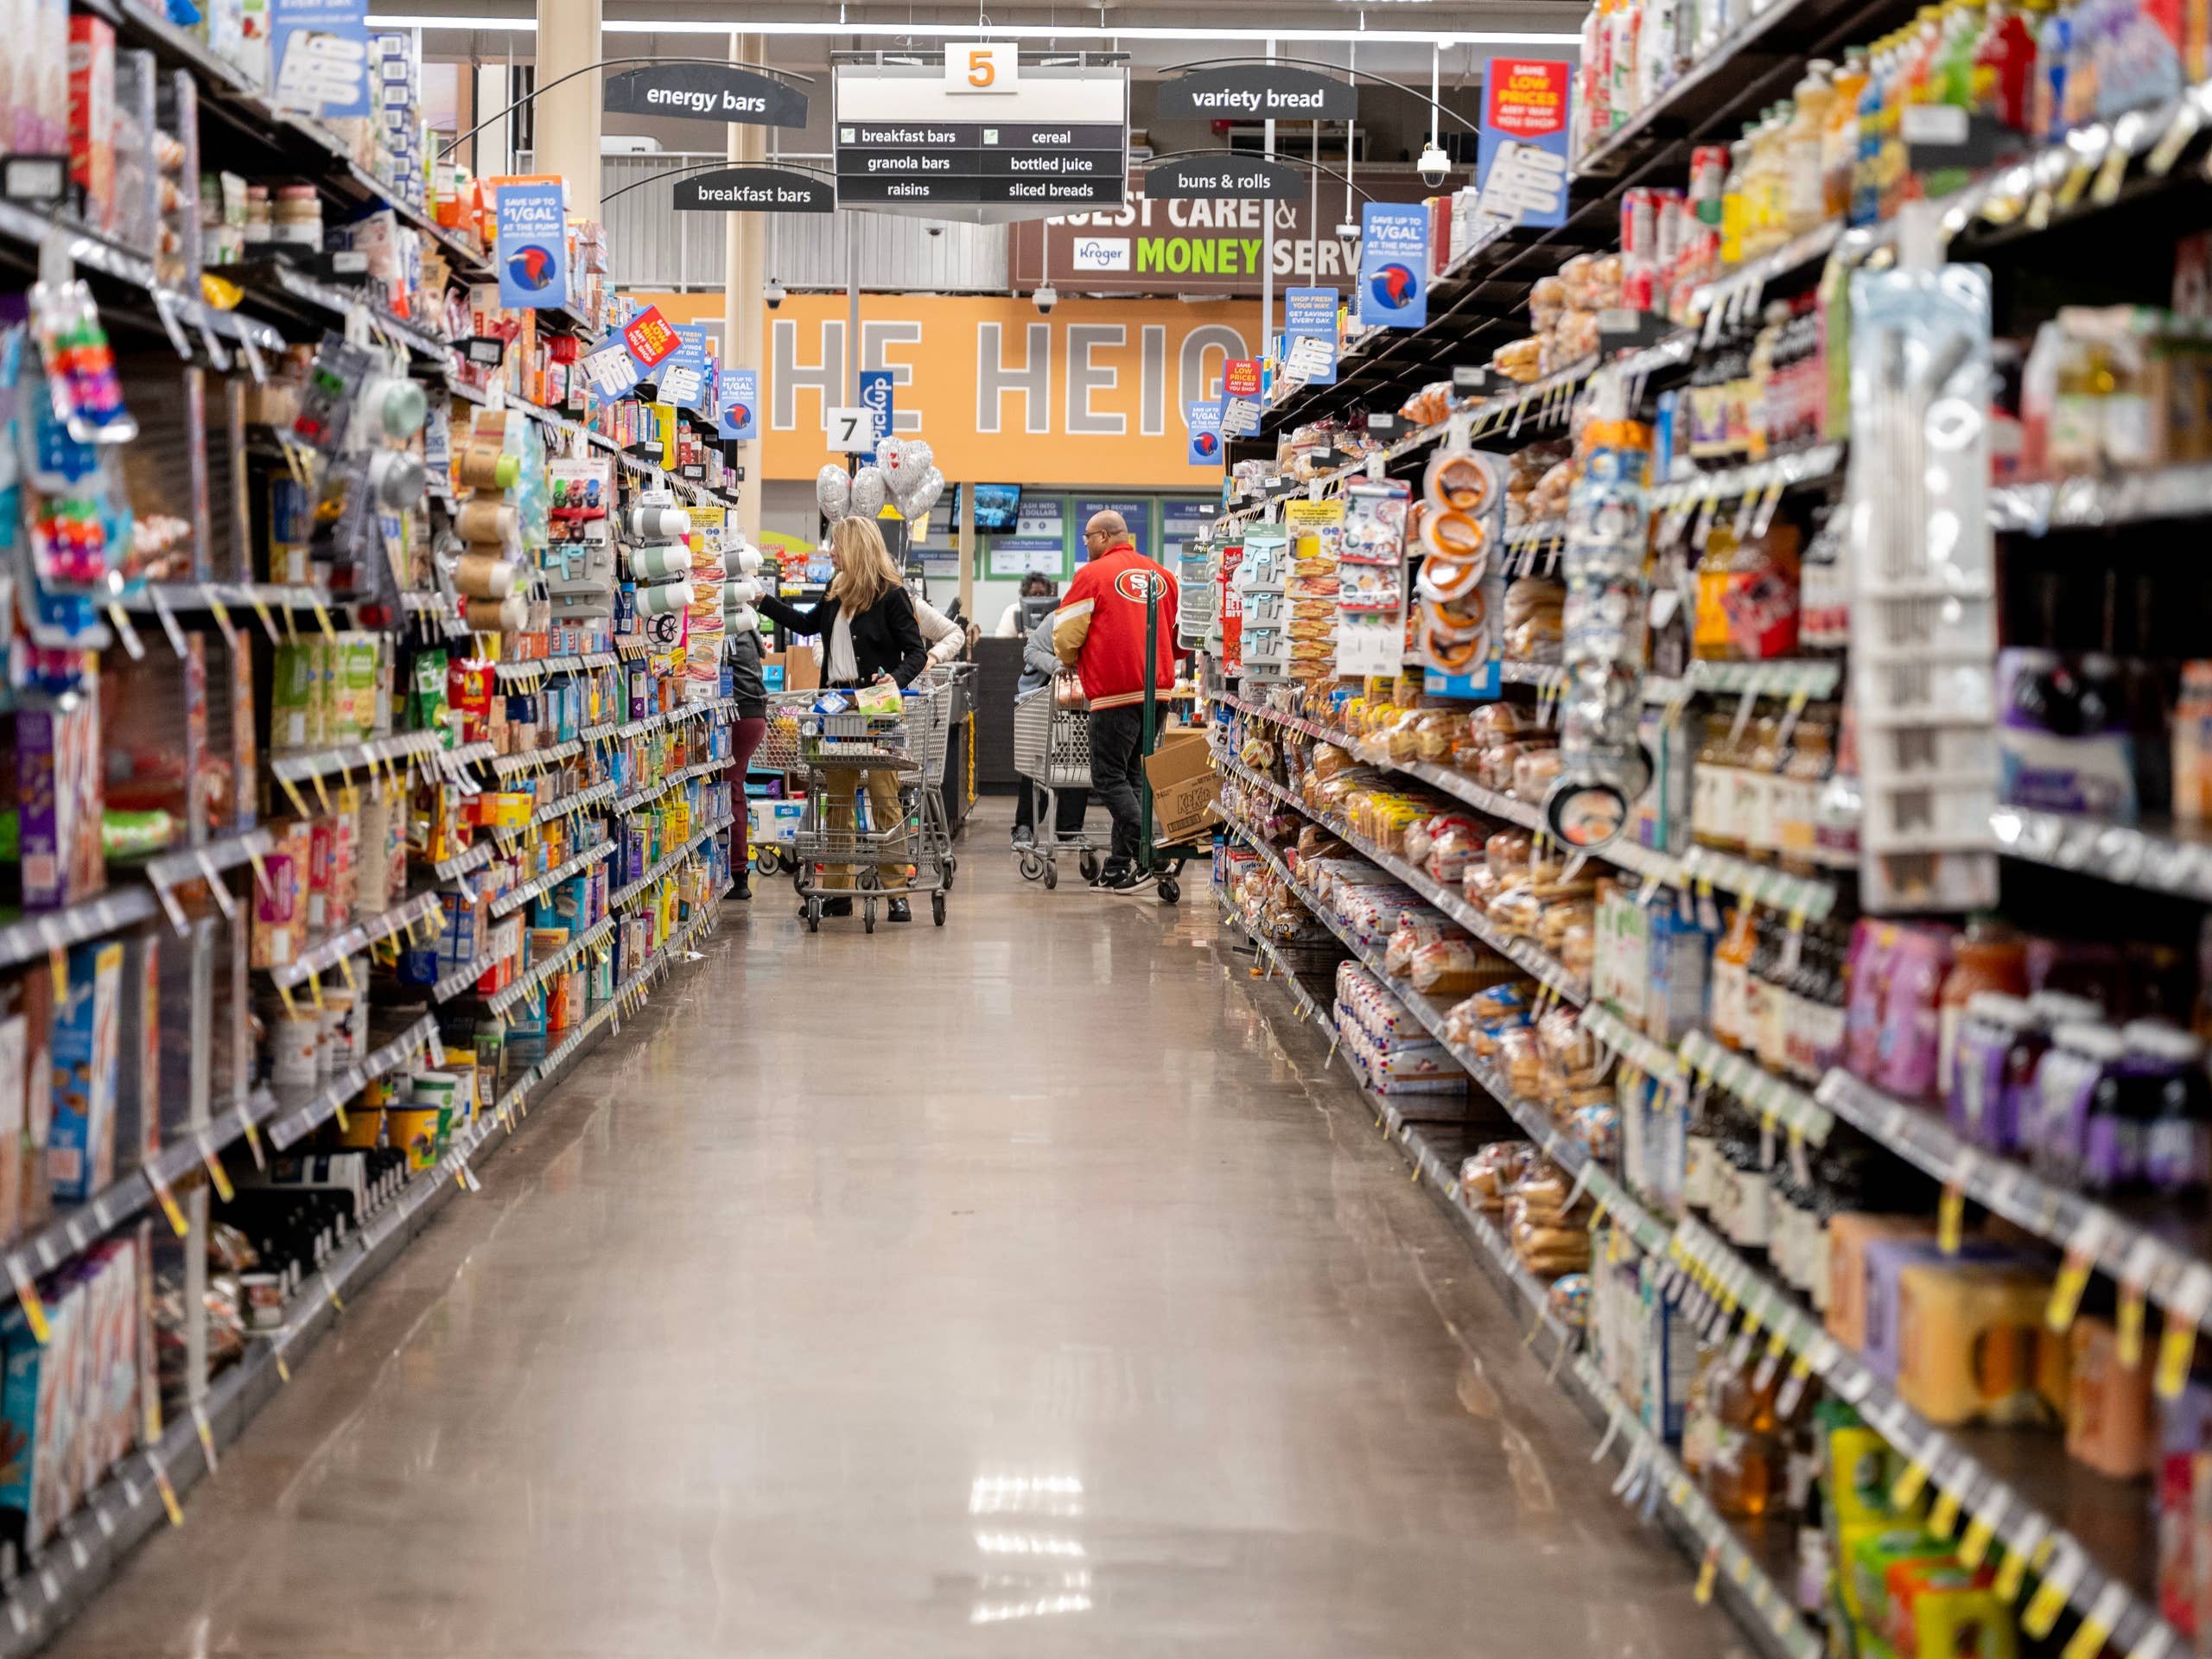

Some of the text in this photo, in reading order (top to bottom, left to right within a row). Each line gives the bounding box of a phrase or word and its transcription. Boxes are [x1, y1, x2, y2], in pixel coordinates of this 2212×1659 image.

[968, 51, 995, 86] 5
[1509, 76, 1551, 90] LOW
[647, 88, 766, 111] energy bars
[1192, 88, 1324, 111] variety bread
[1498, 89, 1559, 105] PRICES
[861, 130, 956, 143] breakfast bars
[1032, 130, 1071, 143] cereal
[868, 156, 950, 172] granola bars
[1010, 157, 1092, 173] bottled juice
[1179, 173, 1271, 188] buns & rolls
[698, 185, 810, 202] breakfast bars
[887, 182, 930, 196] raisins
[1009, 183, 1093, 197] sliced breads
[1168, 199, 1261, 228] CARE
[1274, 198, 1296, 230] &
[1395, 217, 1407, 226] UP
[1409, 217, 1421, 226] TO
[1080, 242, 1122, 265] Kroger
[1136, 238, 1262, 273] MONEY
[639, 321, 664, 354] PRICES
[649, 321, 668, 343] LOW
[841, 418, 857, 442] 7
